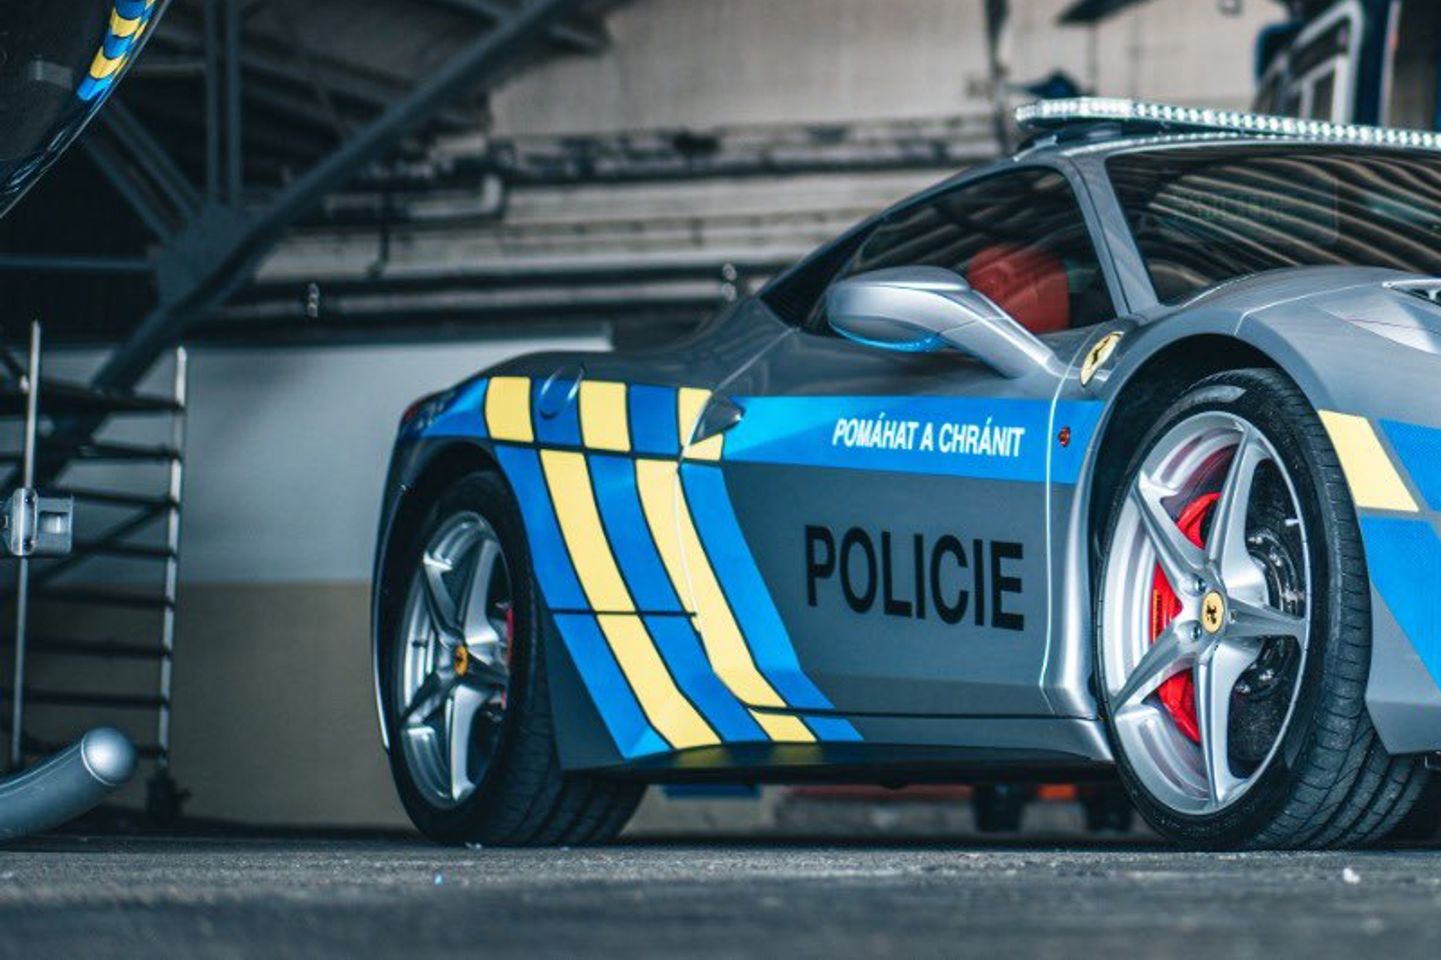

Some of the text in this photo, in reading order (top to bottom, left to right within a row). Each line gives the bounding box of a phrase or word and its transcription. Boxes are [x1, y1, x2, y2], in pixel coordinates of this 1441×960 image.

[832, 412, 1025, 457] POMÁHAT A CHRÁNIT
[805, 525, 1024, 631] POLICIE
